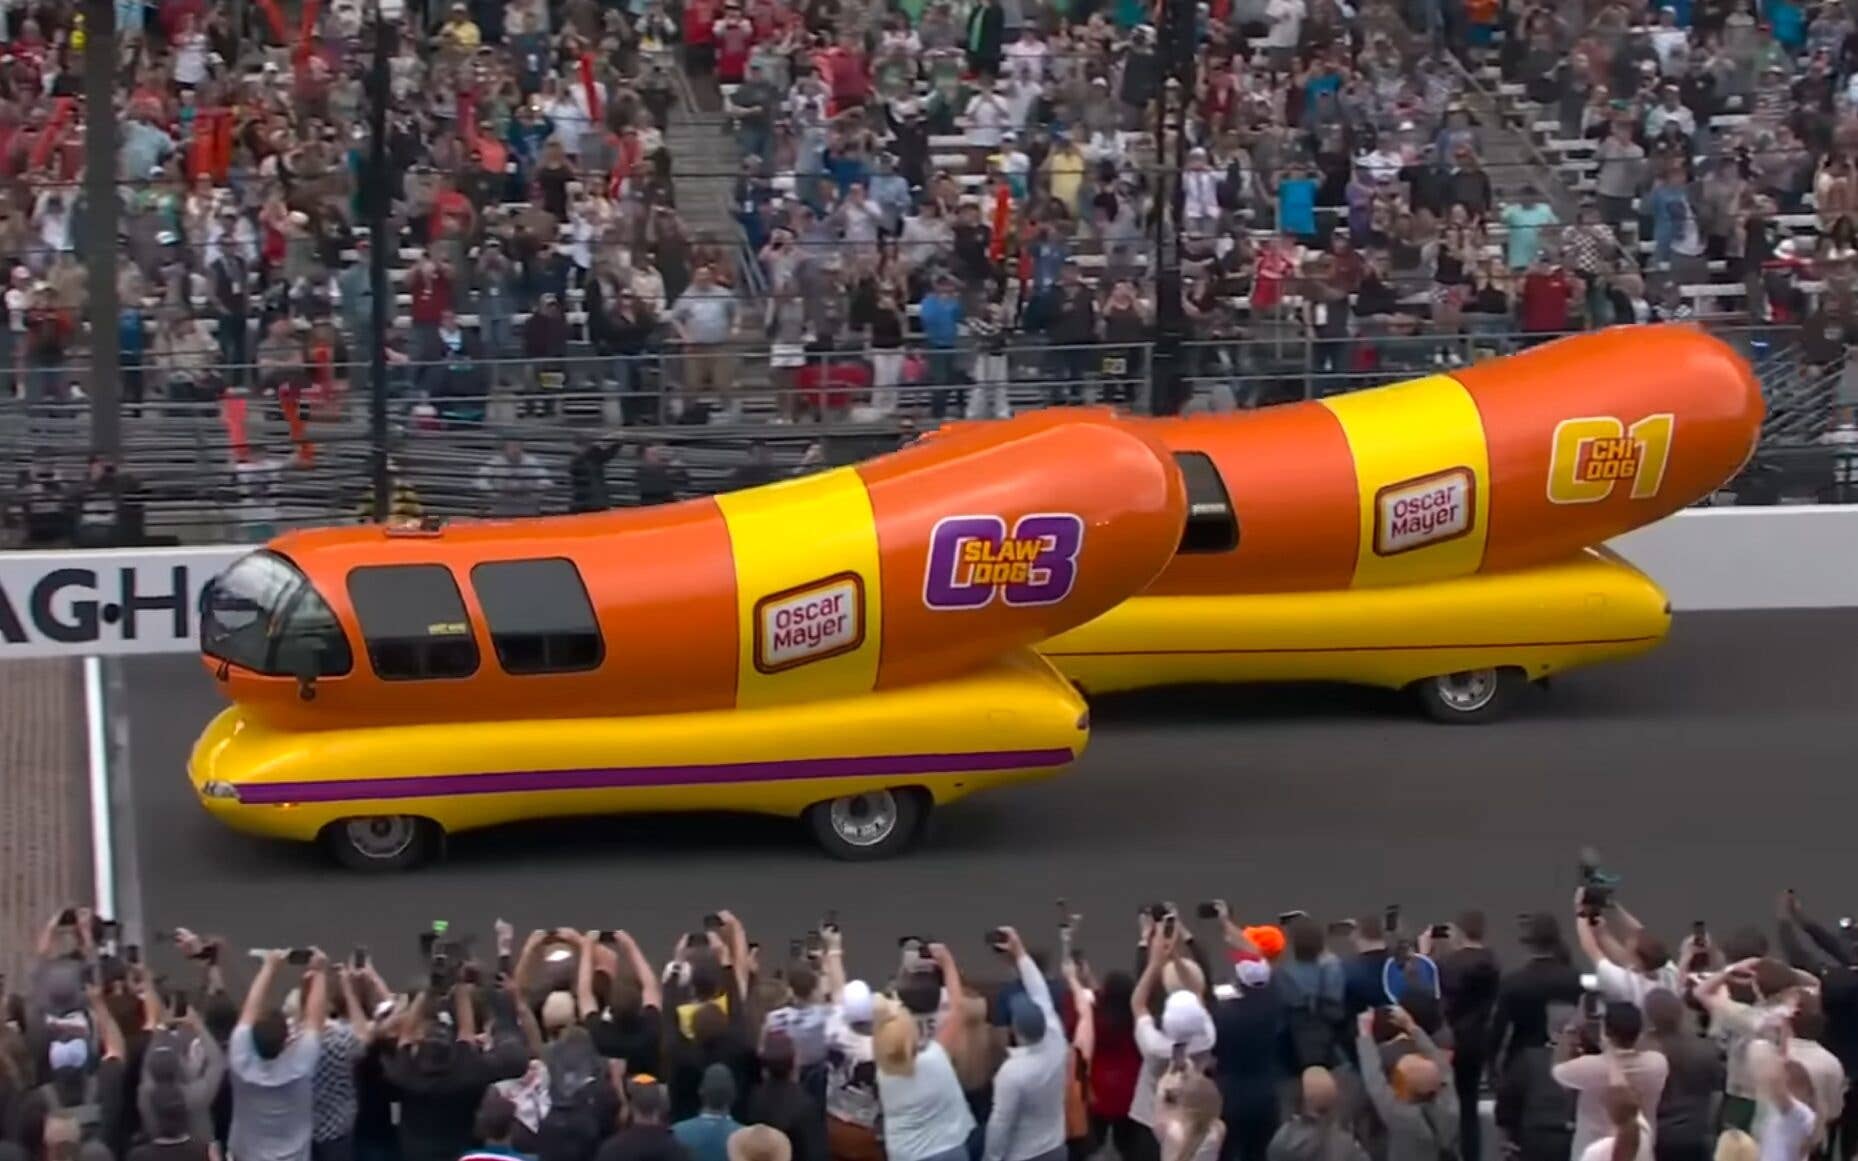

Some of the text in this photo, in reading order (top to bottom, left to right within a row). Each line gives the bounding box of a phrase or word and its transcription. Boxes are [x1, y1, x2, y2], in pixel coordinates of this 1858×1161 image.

[1592, 439, 1634, 460] CHI
[1586, 459, 1636, 480] DOG
[1394, 486, 1457, 518] Oscar
[1391, 504, 1460, 539] Mayer
[964, 540, 1042, 561] SLAW
[973, 561, 1032, 584] DOG
[775, 593, 845, 630] Oscar
[773, 614, 848, 652] Mayer
